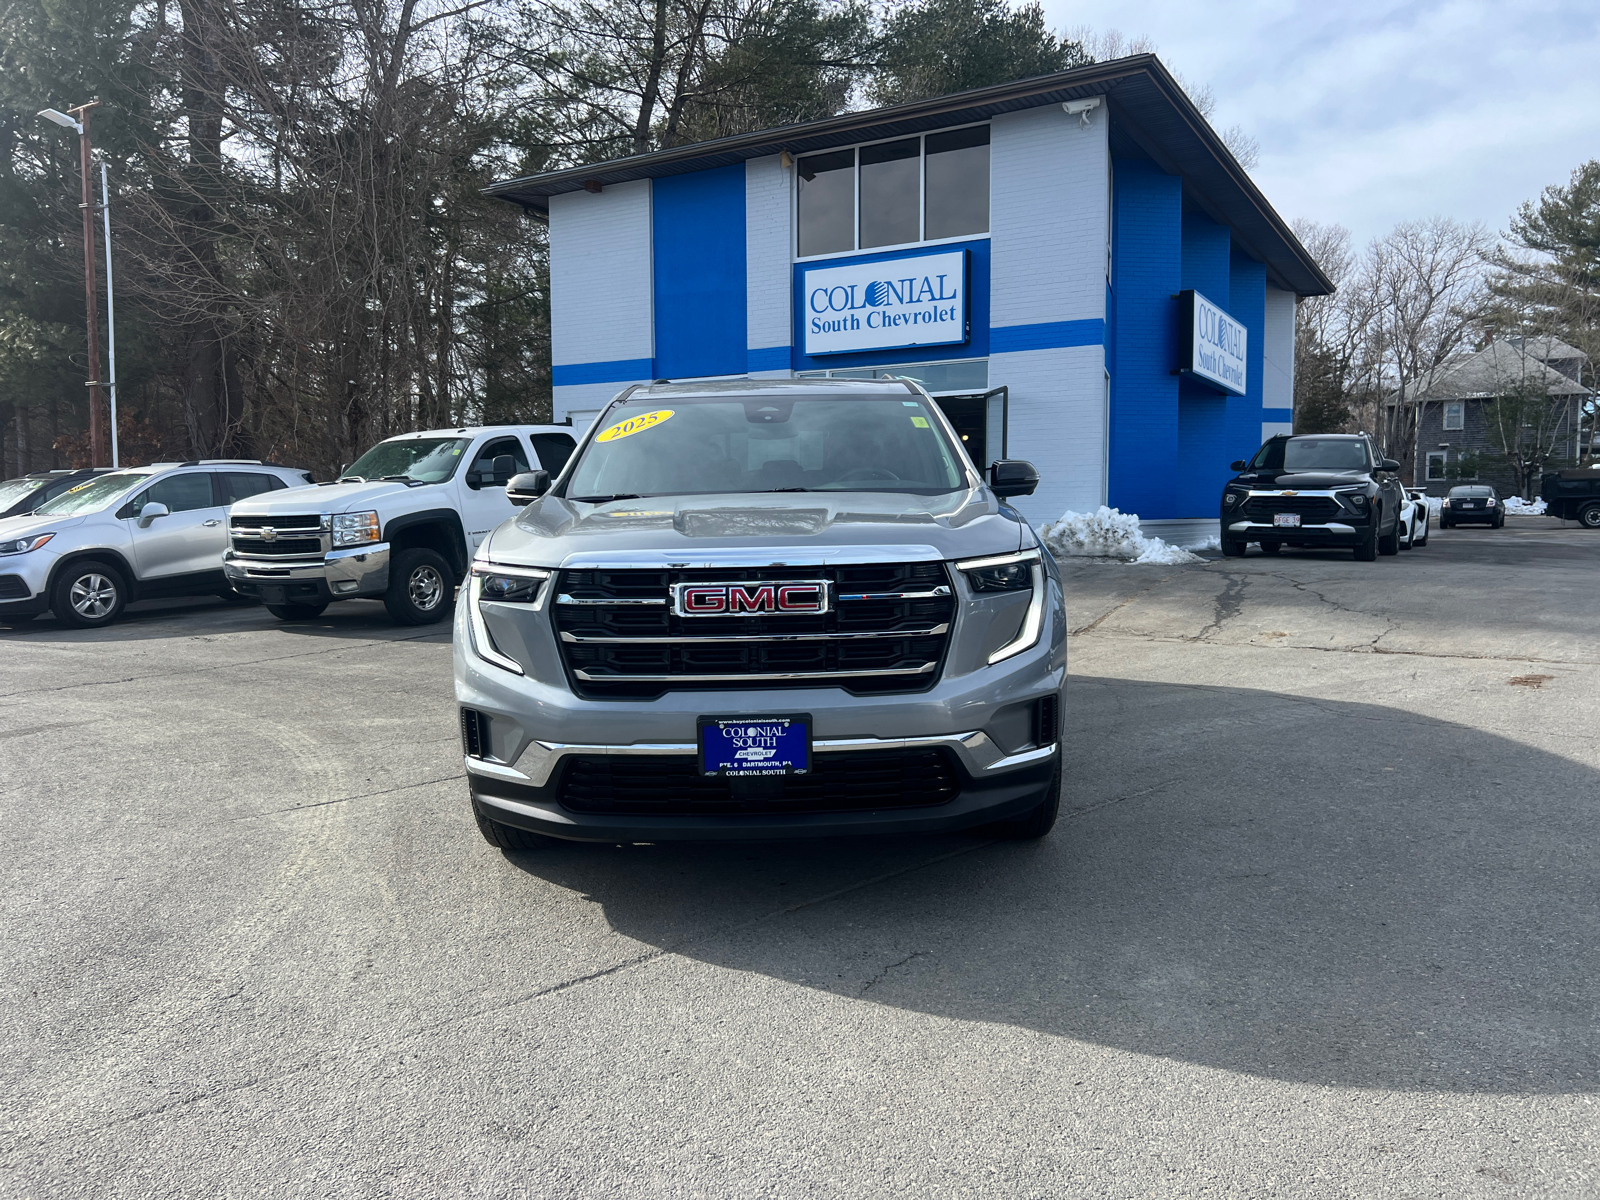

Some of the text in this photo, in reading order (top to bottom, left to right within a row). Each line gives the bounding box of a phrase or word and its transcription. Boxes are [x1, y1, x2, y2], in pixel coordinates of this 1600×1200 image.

[810, 274, 957, 314] COLONIAL
[811, 305, 957, 334] South Chevrolet
[1198, 303, 1244, 362] COLONIAL
[1198, 344, 1243, 387] South Chevrolet
[611, 412, 659, 439] 2025
[684, 585, 820, 612] GMC
[722, 726, 787, 738] COLONIAL
[732, 736, 777, 748] SOUTH
